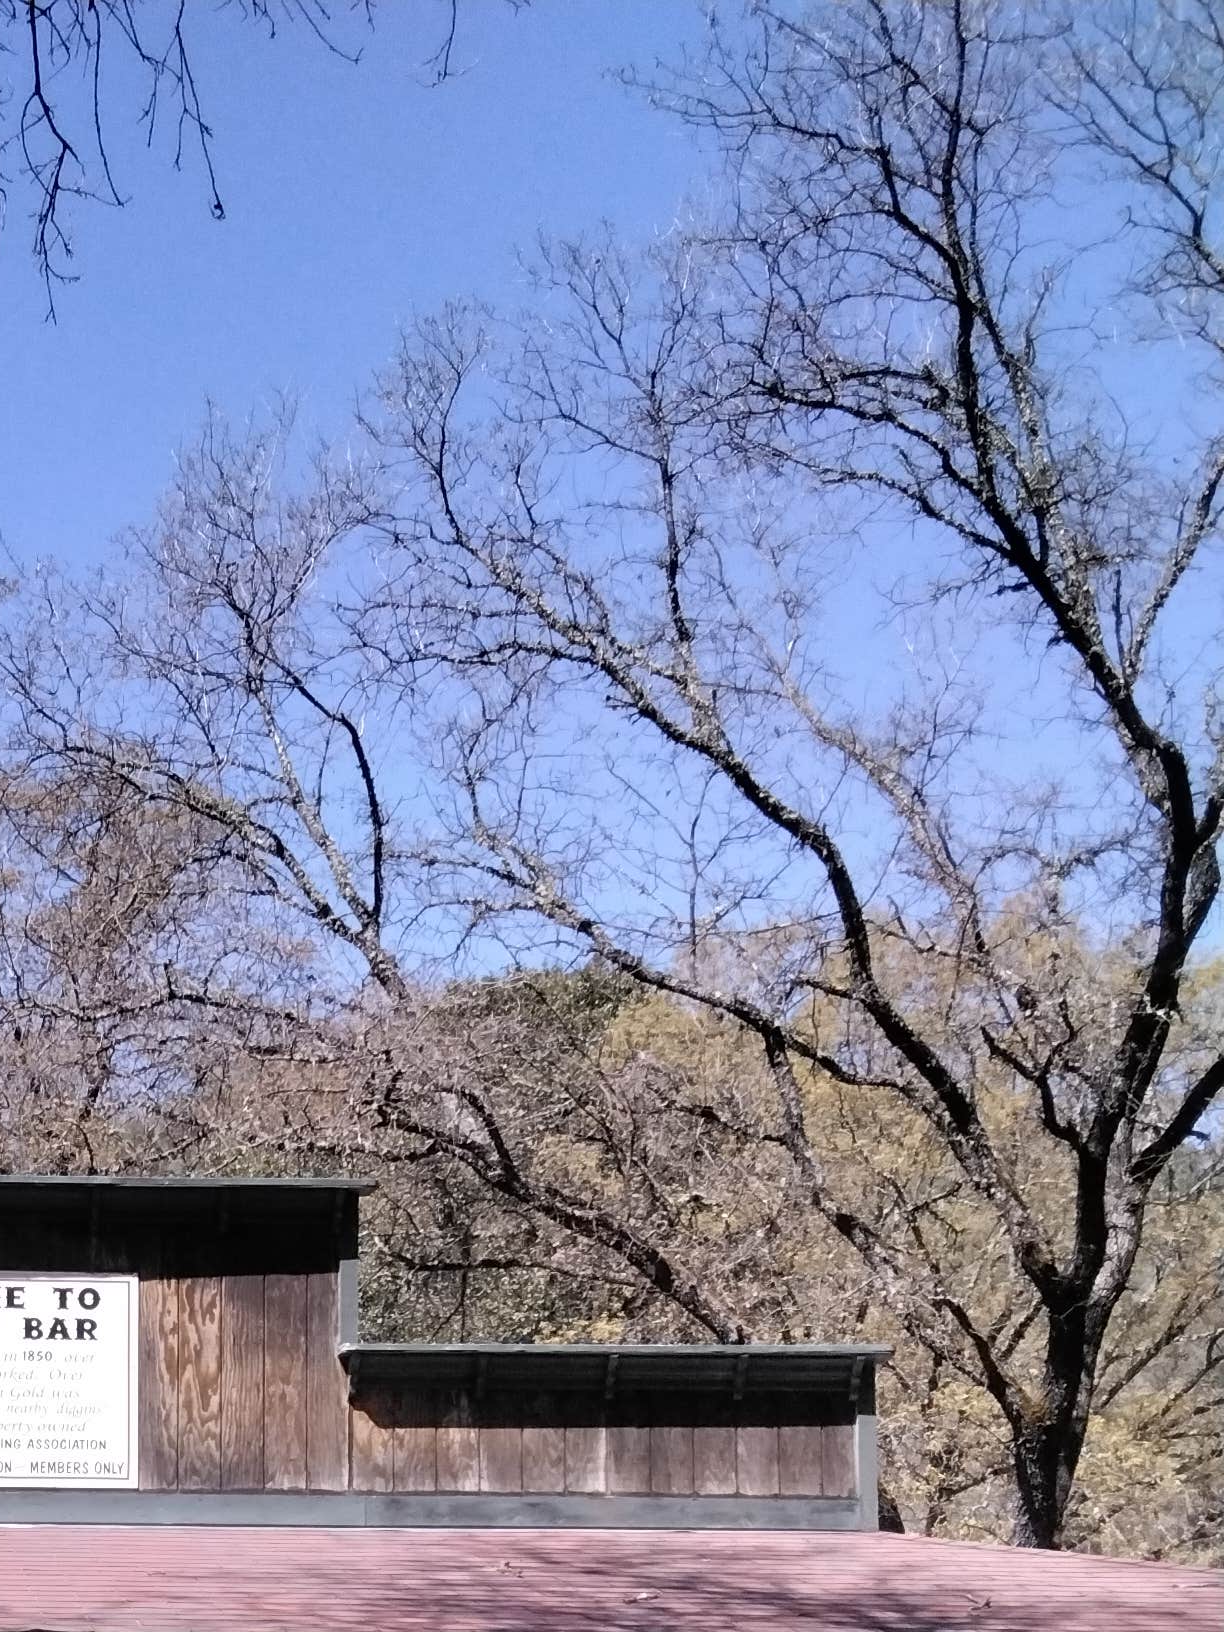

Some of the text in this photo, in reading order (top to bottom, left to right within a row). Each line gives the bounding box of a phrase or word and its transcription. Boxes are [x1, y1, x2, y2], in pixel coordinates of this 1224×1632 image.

[52, 1286, 101, 1310] TO
[22, 1317, 98, 1341] BAR
[26, 1438, 108, 1451] ASSOCIATION
[29, 1460, 90, 1476] MEMBERS
[94, 1462, 126, 1476] ONLY
